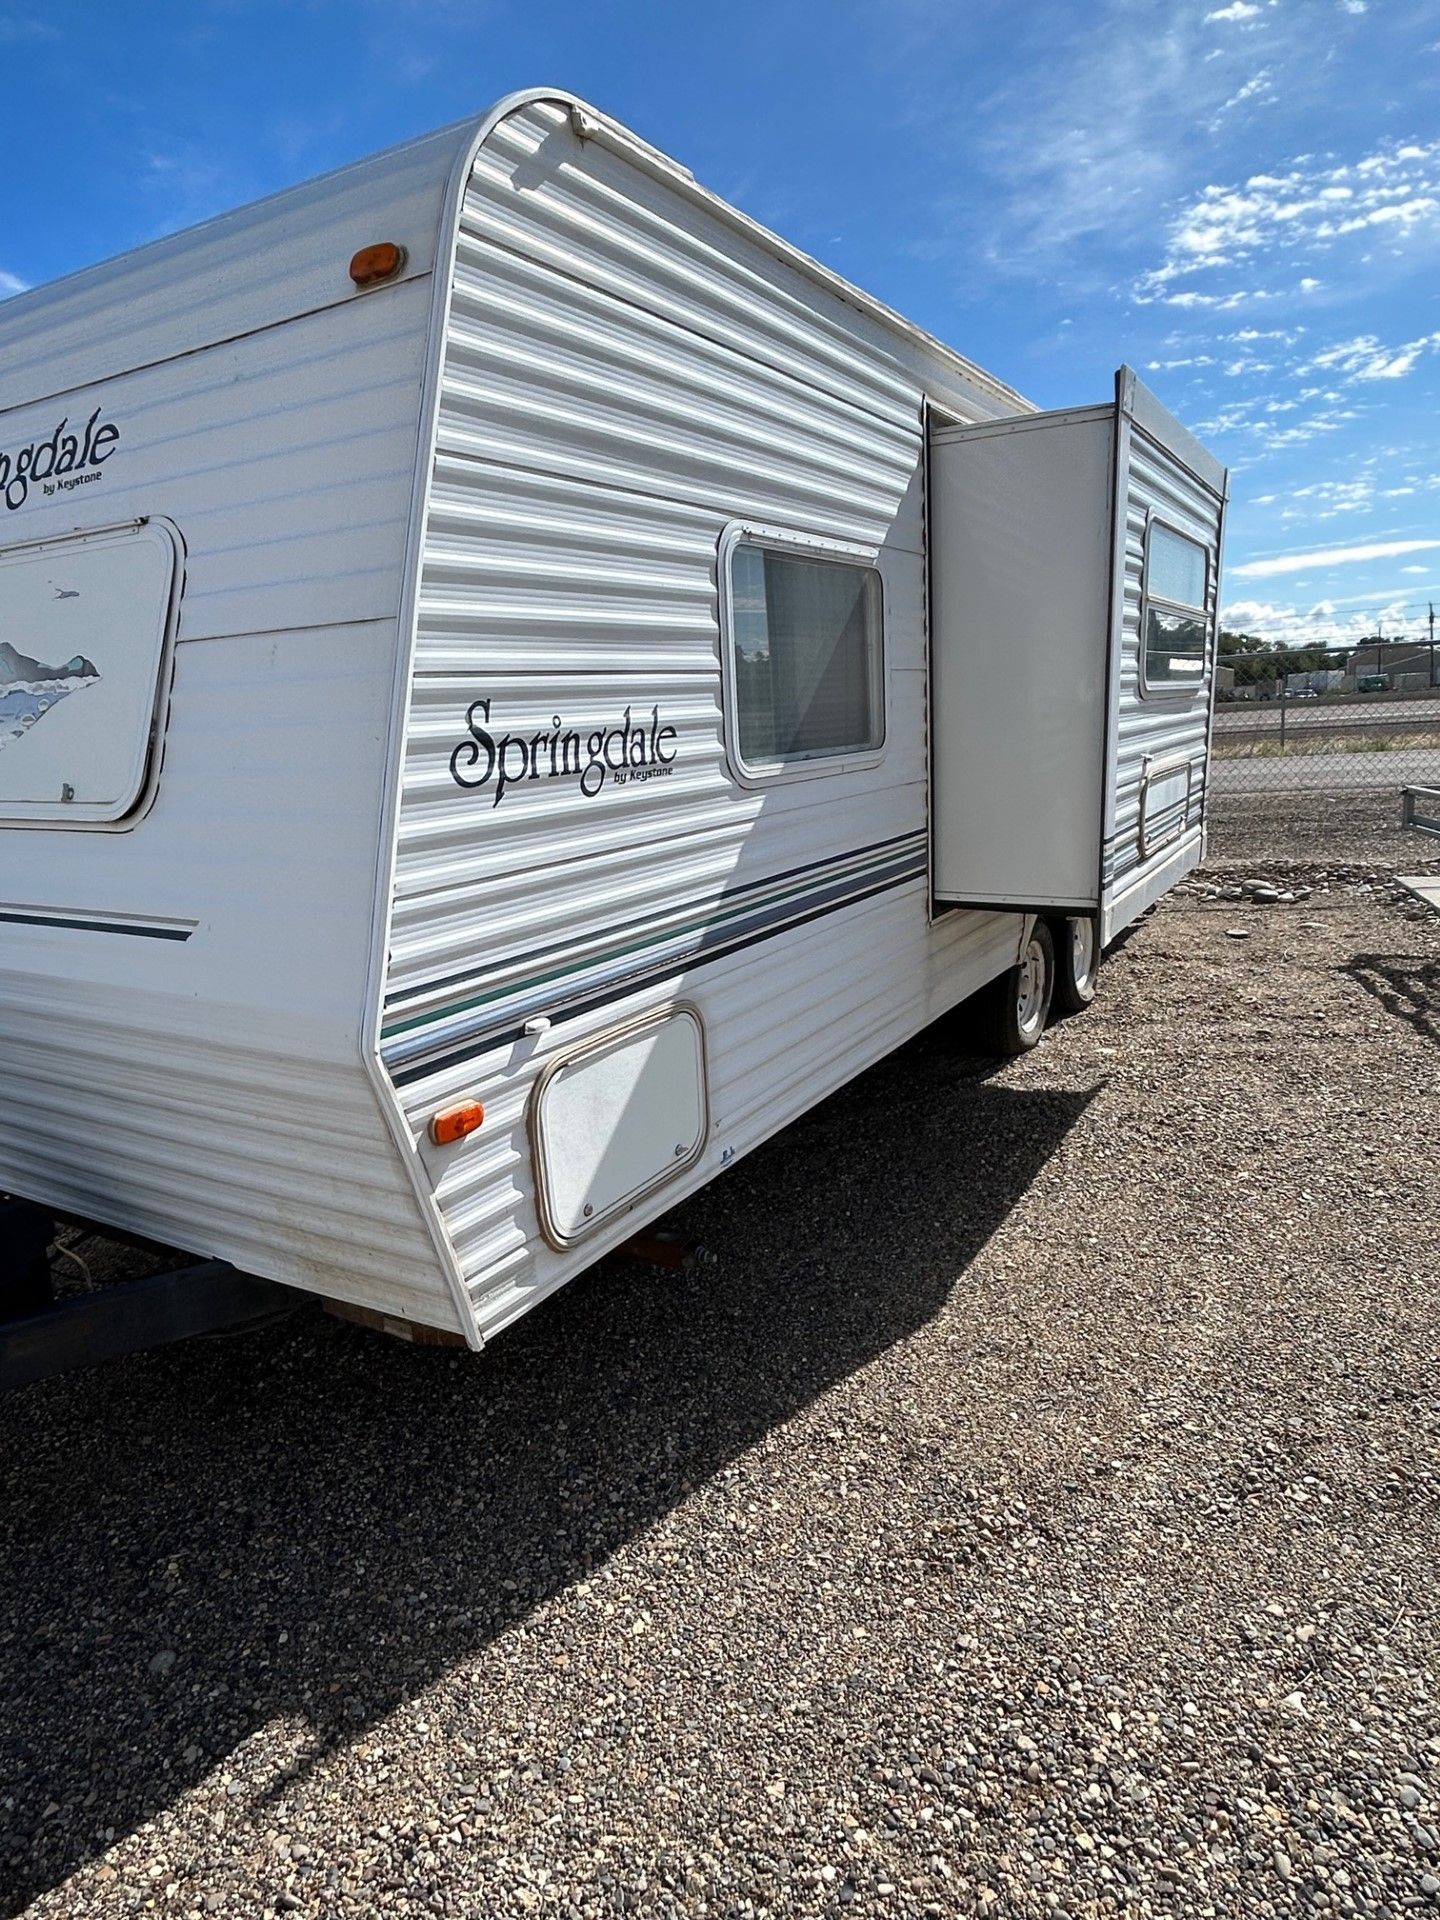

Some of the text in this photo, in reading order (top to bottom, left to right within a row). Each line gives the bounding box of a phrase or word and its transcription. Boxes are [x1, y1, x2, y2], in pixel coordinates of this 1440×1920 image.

[43, 470, 102, 495] by Keystone
[450, 698, 677, 808] Springdale
[614, 767, 673, 785] by Keystone
